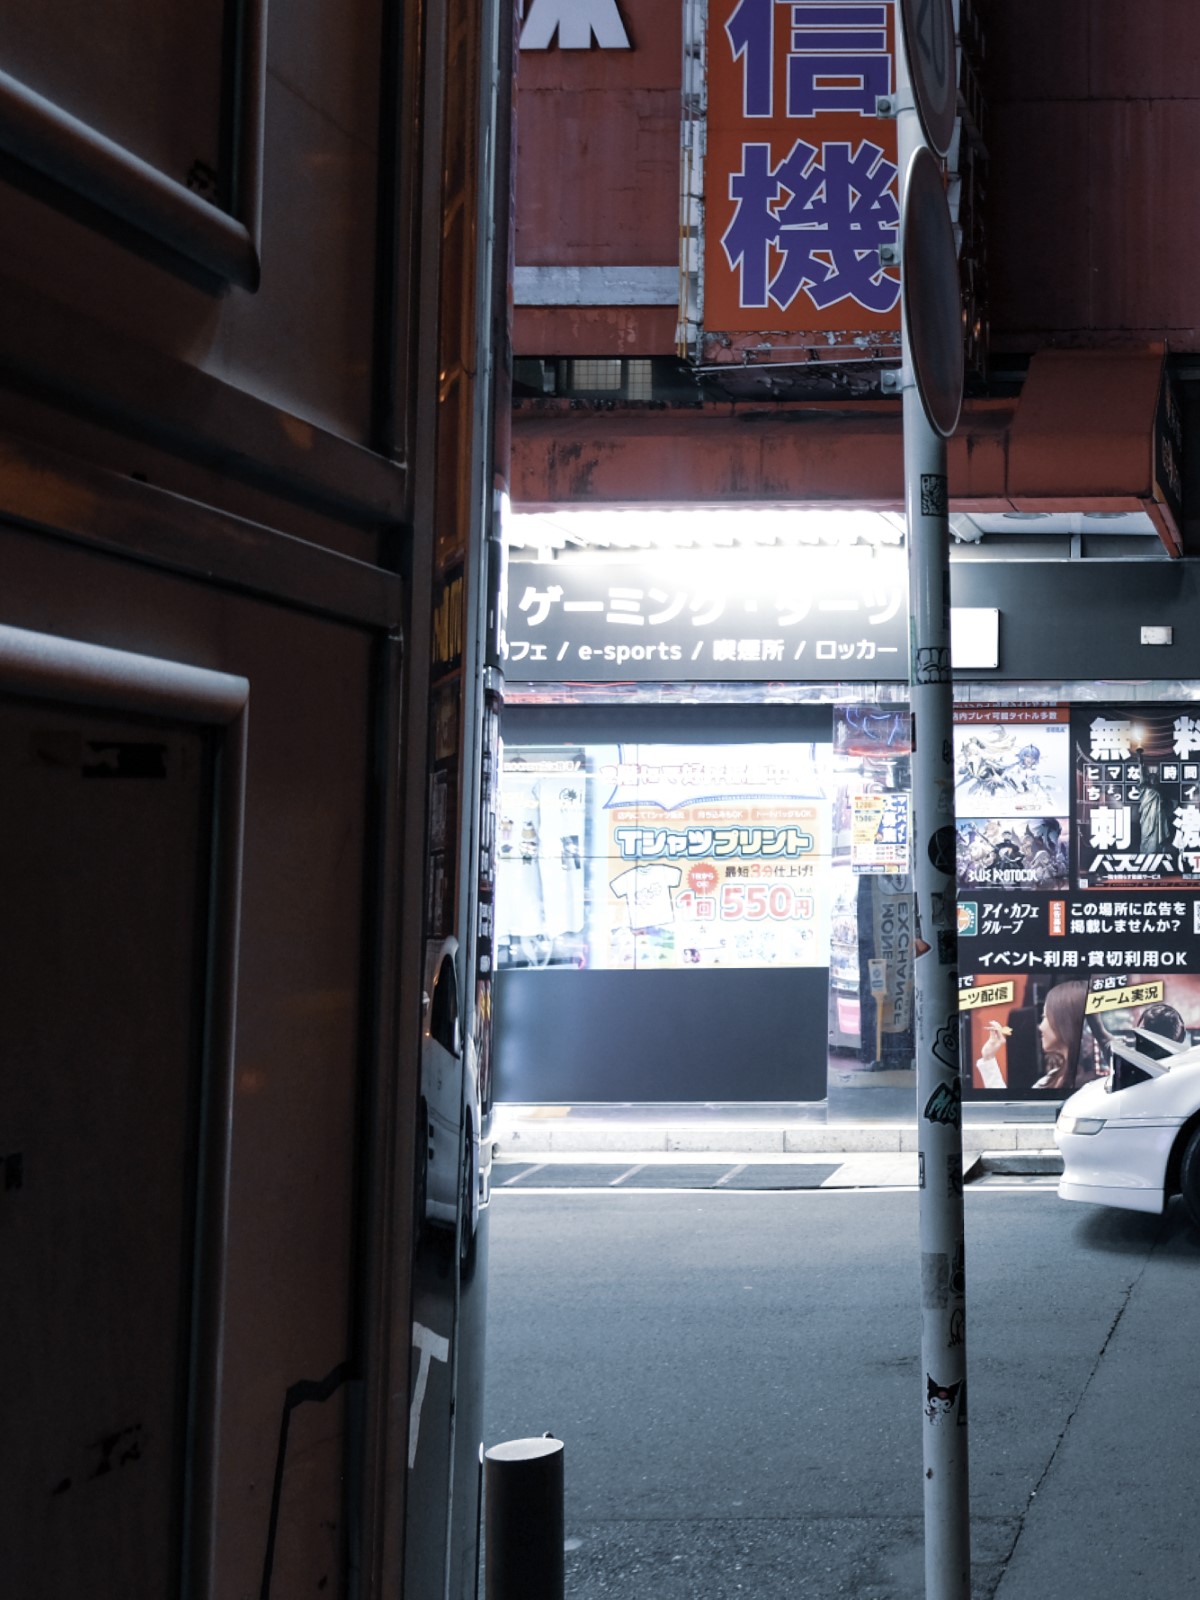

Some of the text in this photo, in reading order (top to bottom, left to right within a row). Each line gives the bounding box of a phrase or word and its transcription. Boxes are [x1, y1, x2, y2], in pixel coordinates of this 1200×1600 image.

[578, 641, 682, 665] e-sports
[816, 639, 898, 661] ロッカー
[616, 827, 814, 858] Tシャツプリント
[724, 863, 814, 879] 最短3分仕上げ!
[981, 902, 1040, 919] アイ・カフェ
[1070, 902, 1187, 917] この場所に広告を
[981, 919, 1024, 935] グループ
[1070, 918, 1181, 934] 掲載しませんか?
[978, 950, 1188, 968] イベント利用・貸切利用OK
[1092, 974, 1128, 990] お店で
[1091, 985, 1159, 1009] ゲーム実況
